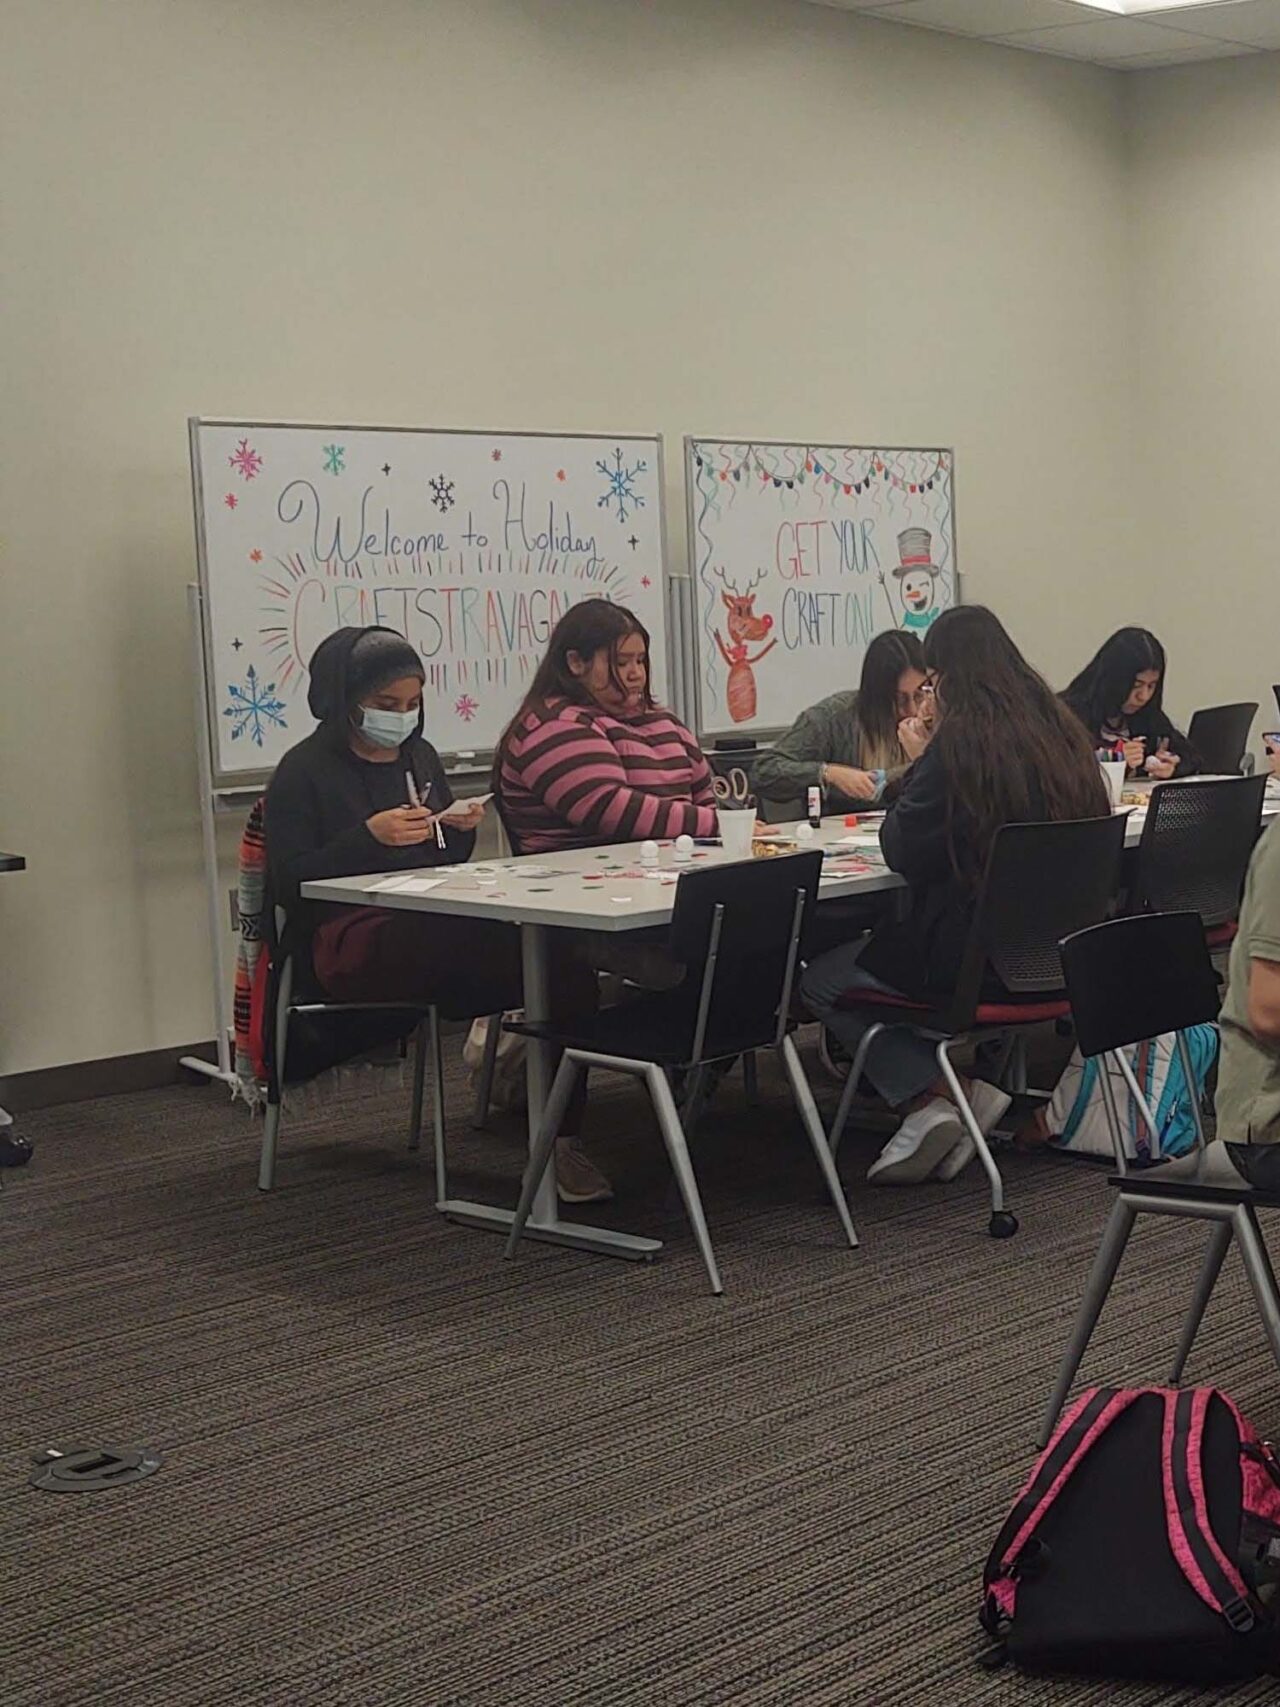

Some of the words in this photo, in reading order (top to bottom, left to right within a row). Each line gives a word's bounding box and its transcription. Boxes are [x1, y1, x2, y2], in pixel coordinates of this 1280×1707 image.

[278, 479, 449, 563] Welcome
[461, 511, 489, 548] to
[492, 479, 605, 579] Holiday
[776, 520, 828, 581] GET
[830, 518, 881, 575] YOUR
[294, 578, 611, 671] CRAFTSTRAVAGA
[782, 587, 842, 651] CRAFT
